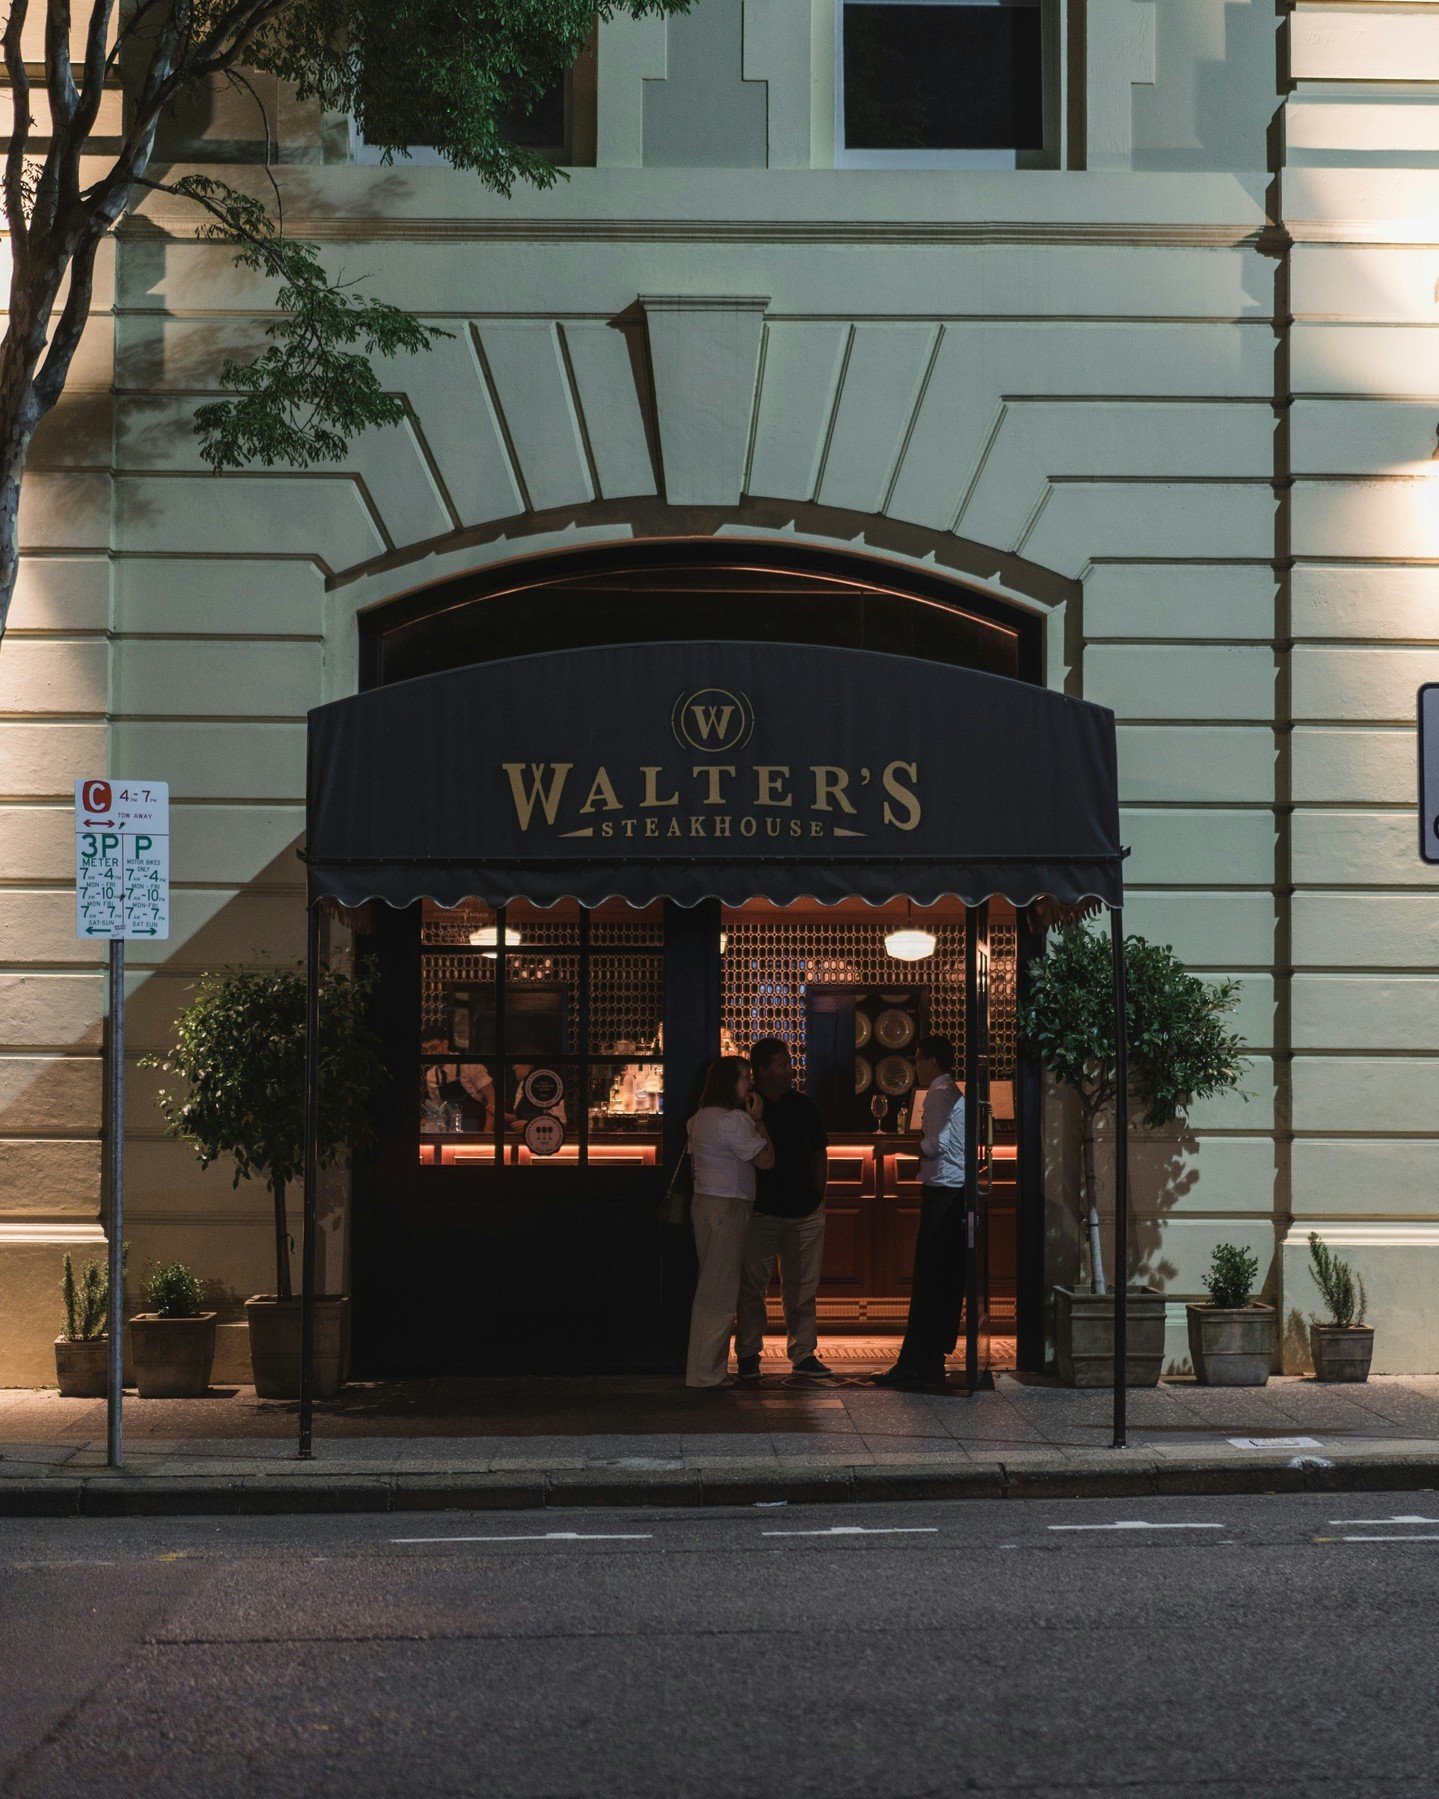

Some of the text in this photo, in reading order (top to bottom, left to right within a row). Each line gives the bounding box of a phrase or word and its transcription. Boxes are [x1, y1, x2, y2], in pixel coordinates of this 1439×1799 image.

[690, 705, 735, 740] W
[89, 783, 106, 811] C
[502, 760, 922, 831] WALTER'S
[601, 816, 824, 838] STEAKHOUSE
[81, 833, 119, 858] 3P
[135, 835, 152, 859] P
[82, 858, 119, 867] METER
